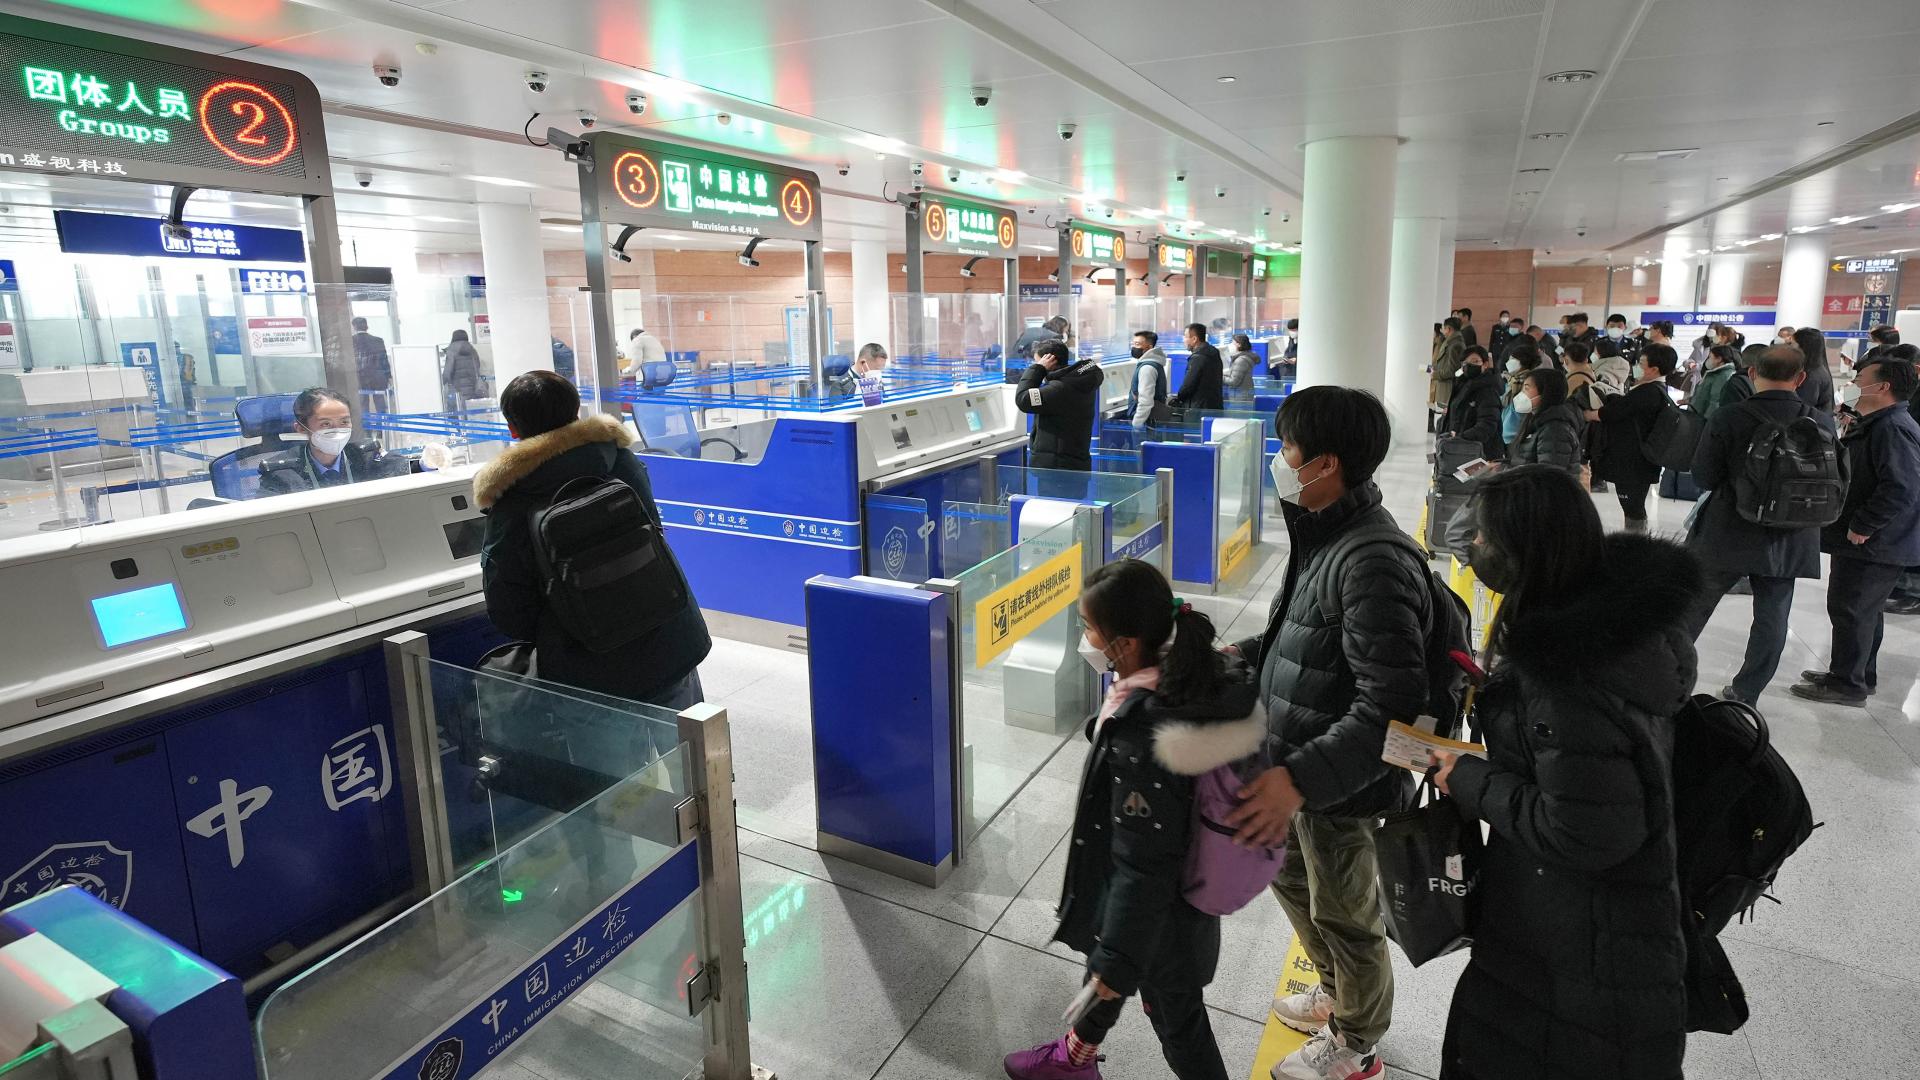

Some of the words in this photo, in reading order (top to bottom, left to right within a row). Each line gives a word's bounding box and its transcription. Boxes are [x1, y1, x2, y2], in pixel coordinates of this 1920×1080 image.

[25, 66, 191, 121] 团体人员
[59, 109, 170, 144] Groups
[232, 101, 267, 145] 2
[20, 153, 128, 176] 盛视科技
[627, 165, 648, 195] 3
[699, 164, 768, 198] 中国边检
[692, 220, 729, 233] Maxvision
[708, 511, 748, 525] 中国边检
[799, 522, 843, 538] 中国边检
[1010, 564, 1071, 616] 请在黄线外排队候检
[1010, 616, 1023, 627] Please
[186, 723, 392, 868] 中国
[13, 852, 106, 895] 中国边检
[482, 903, 632, 1036] 中国边检
[487, 1026, 519, 1056] CHINA
[523, 973, 583, 1027] IMMIGRATION
[586, 931, 634, 975] INSPECTION
